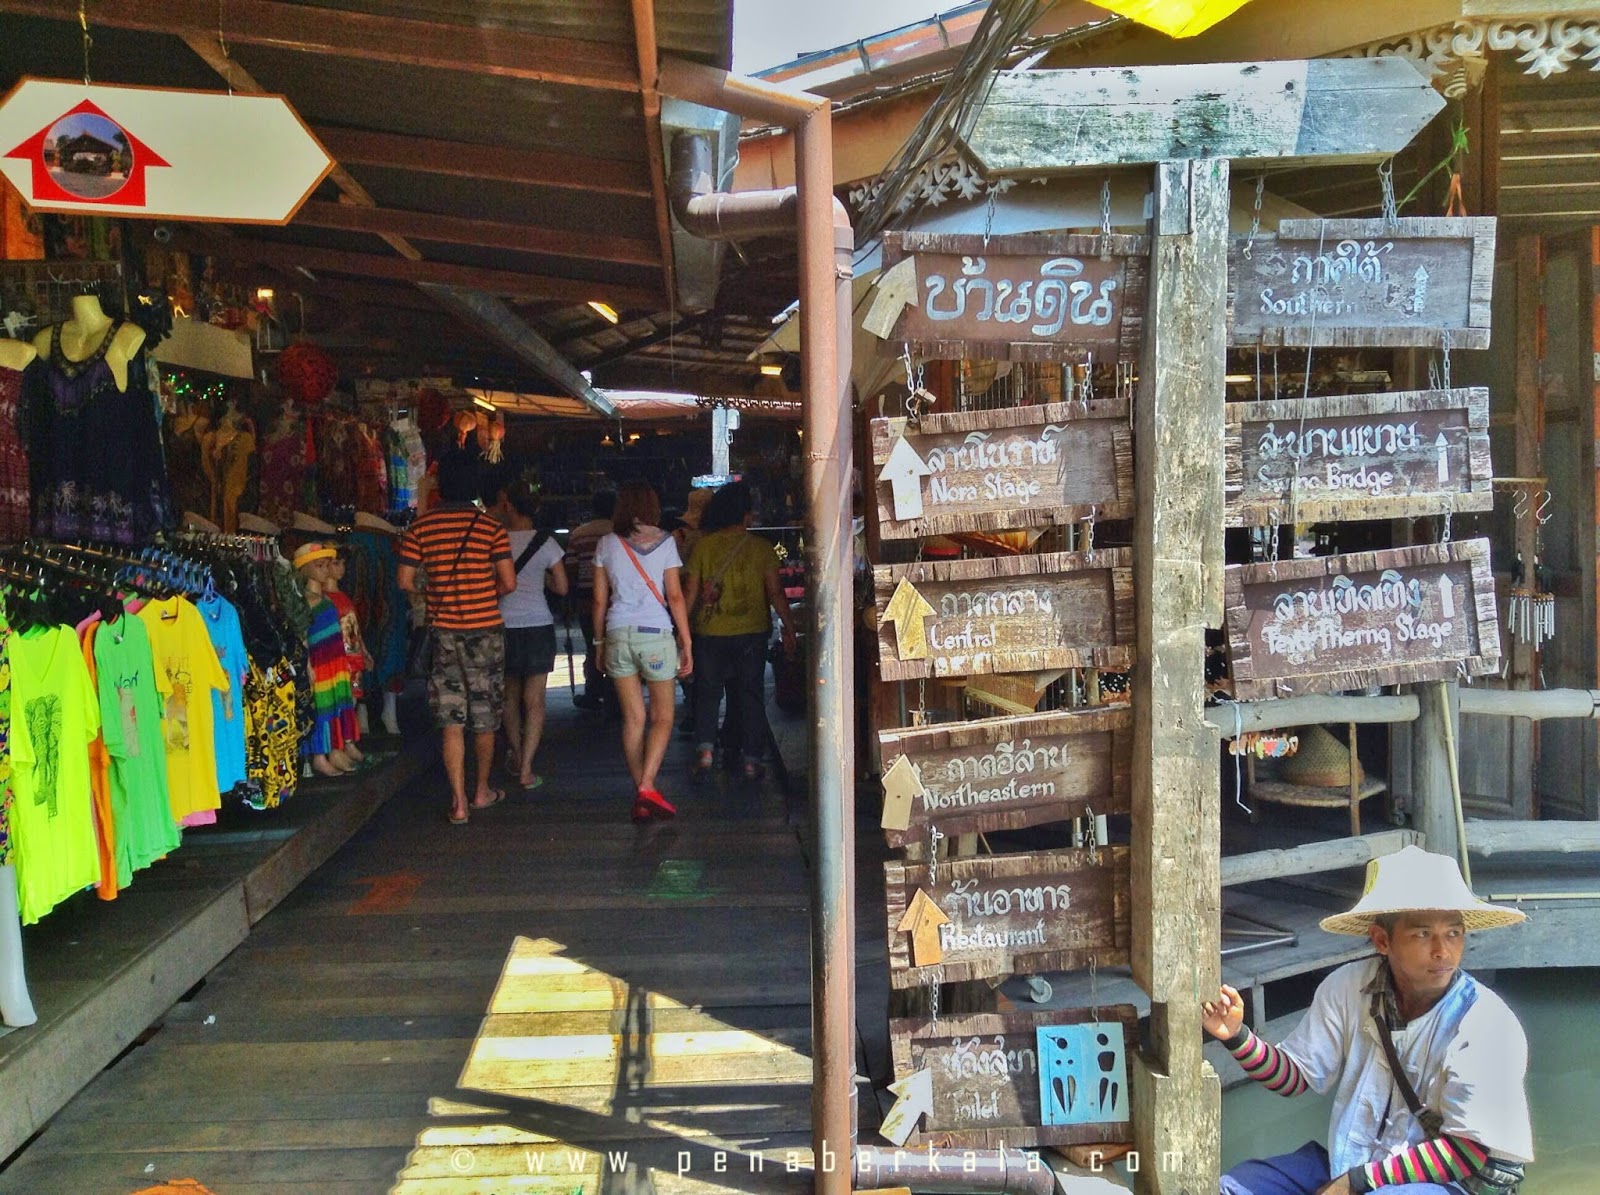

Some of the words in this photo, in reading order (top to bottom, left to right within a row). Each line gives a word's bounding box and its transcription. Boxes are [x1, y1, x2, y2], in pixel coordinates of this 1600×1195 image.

[1290, 239, 1394, 285] ภาคใต้
[925, 256, 1117, 337] บ้านดิน
[1258, 421, 1420, 460] สะพานแขวน
[930, 476, 978, 504] Nora
[984, 472, 1041, 505] Stage
[1326, 462, 1394, 496] Bridge
[940, 589, 1053, 618] ภาคกลาง
[930, 621, 997, 651] Central
[1395, 612, 1453, 649] Stage
[946, 738, 1072, 783] ภาคอีสาน
[923, 777, 1056, 811] Northeastern
[944, 878, 1072, 918] ร้านอาหาร
[940, 917, 1048, 952] Restaurant
[941, 1034, 1037, 1083] ห้องสุขา
